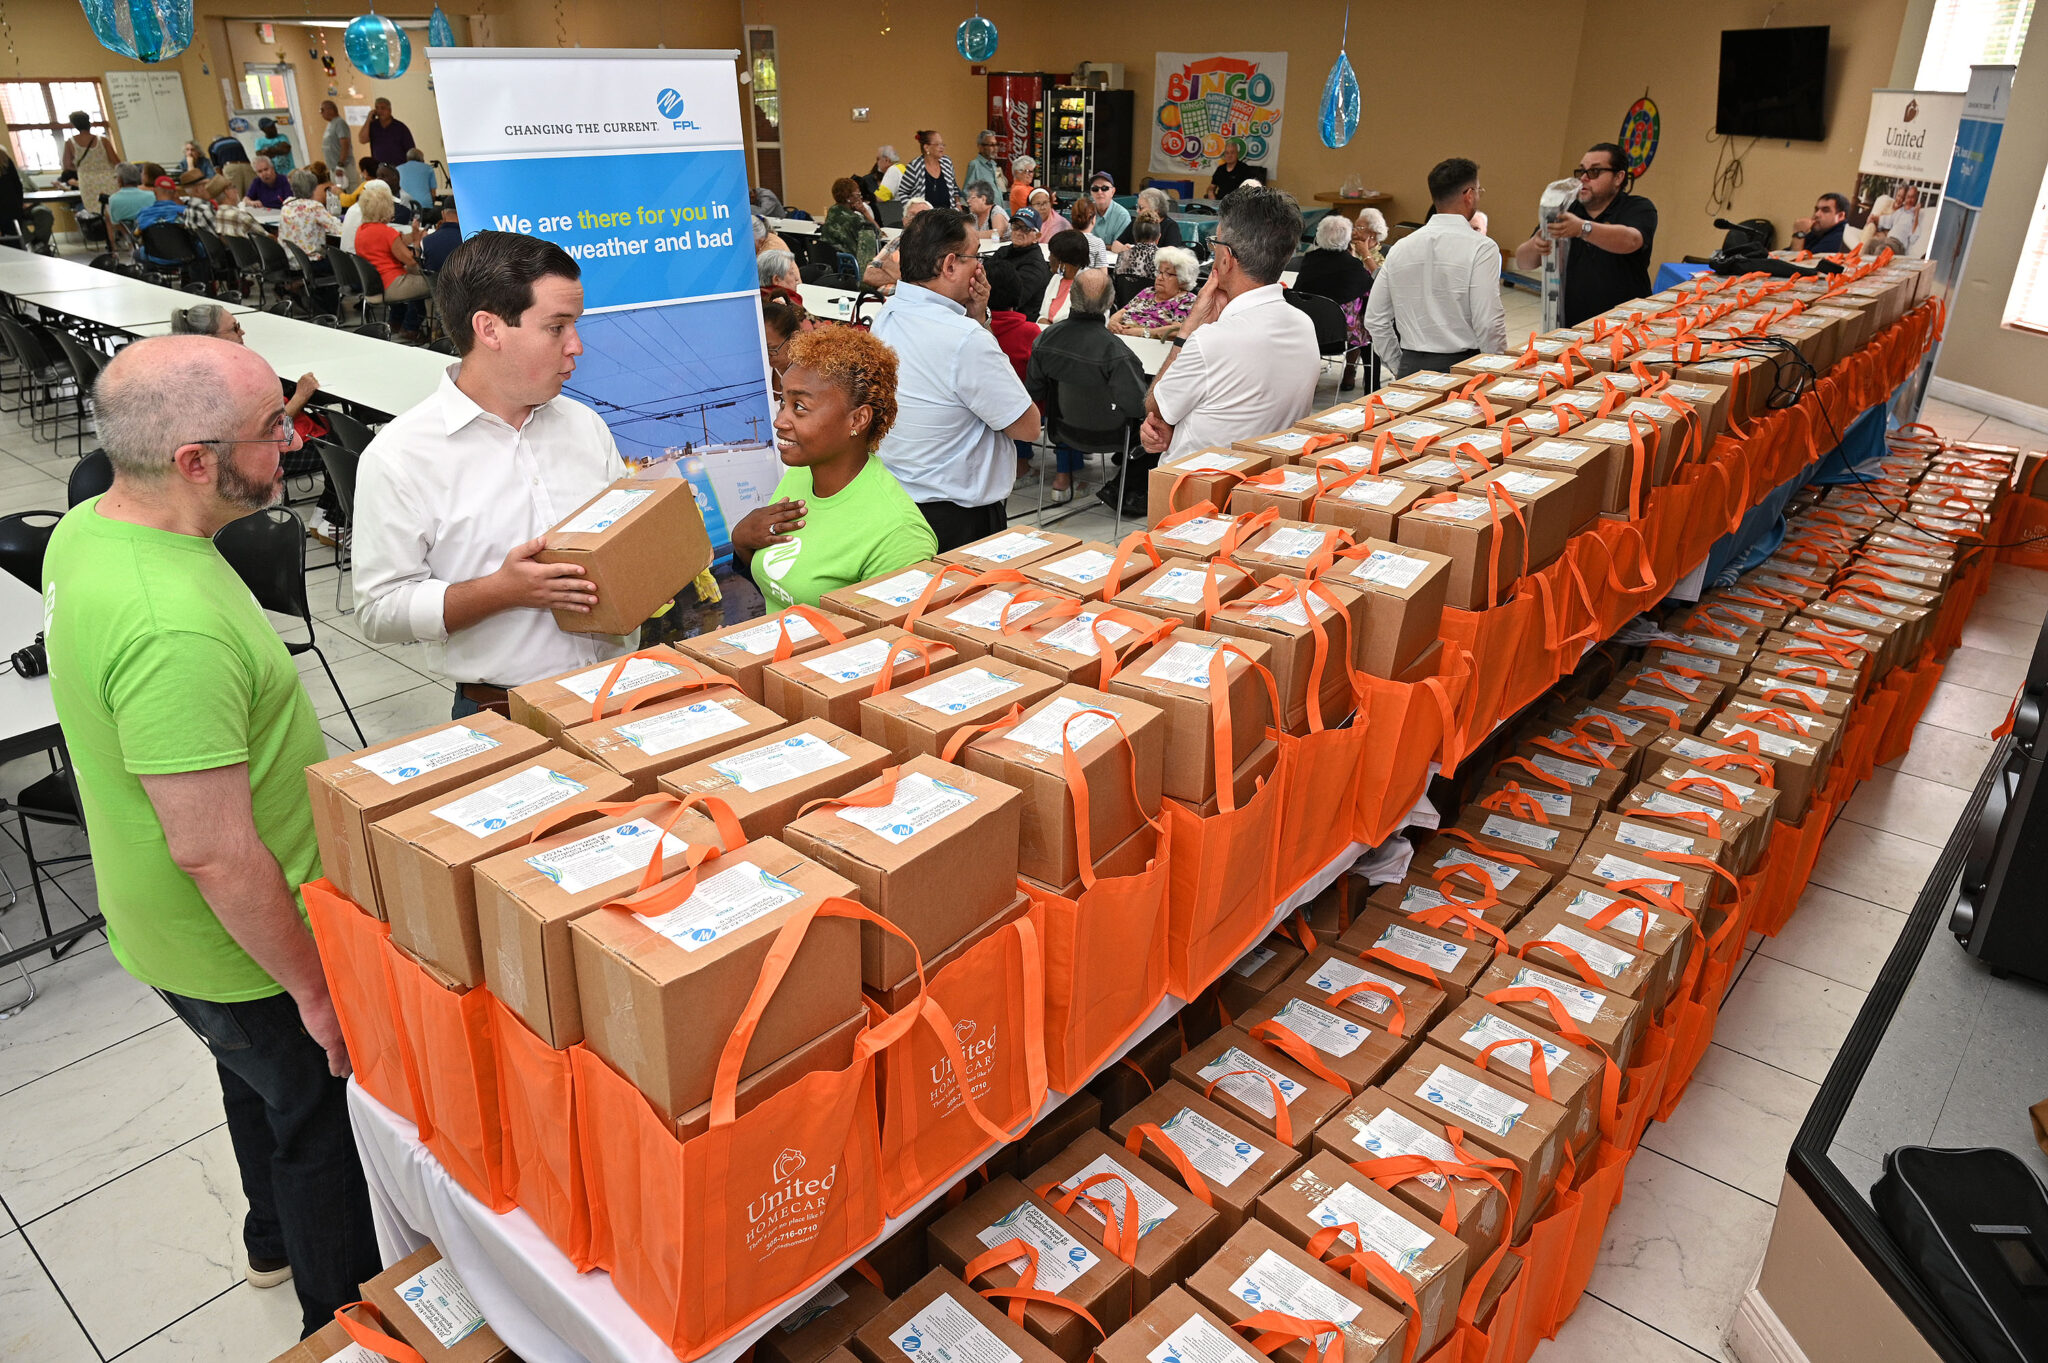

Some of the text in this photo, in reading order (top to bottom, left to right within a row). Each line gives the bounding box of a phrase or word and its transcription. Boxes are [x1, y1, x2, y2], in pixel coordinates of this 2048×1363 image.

[1168, 73, 1272, 103] BINGO
[504, 124, 573, 136] CHANGING
[576, 124, 600, 134] THE
[673, 120, 700, 131] FPL
[1221, 121, 1272, 136] BINGO
[1886, 128, 1926, 148] United
[493, 201, 730, 234] We are there for you in
[564, 227, 734, 260] weather and bad
[930, 1050, 995, 1101] HOMCAR
[746, 1164, 836, 1224] United
[746, 1194, 829, 1244] HOMECAR
[788, 1217, 806, 1226] place
[806, 1212, 818, 1220] like
[1025, 1216, 1052, 1240] Compliments
[1026, 1210, 1048, 1231] Emergency
[1048, 1230, 1061, 1240] Meal
[1029, 1209, 1043, 1220] 2024
[1043, 1219, 1063, 1237] Hurricane
[766, 1224, 818, 1251] 305-716-0710
[1067, 1260, 1080, 1272] FPL
[418, 1275, 428, 1287] FPL
[910, 1323, 923, 1337] FPL
[1168, 1343, 1182, 1358] FPL
